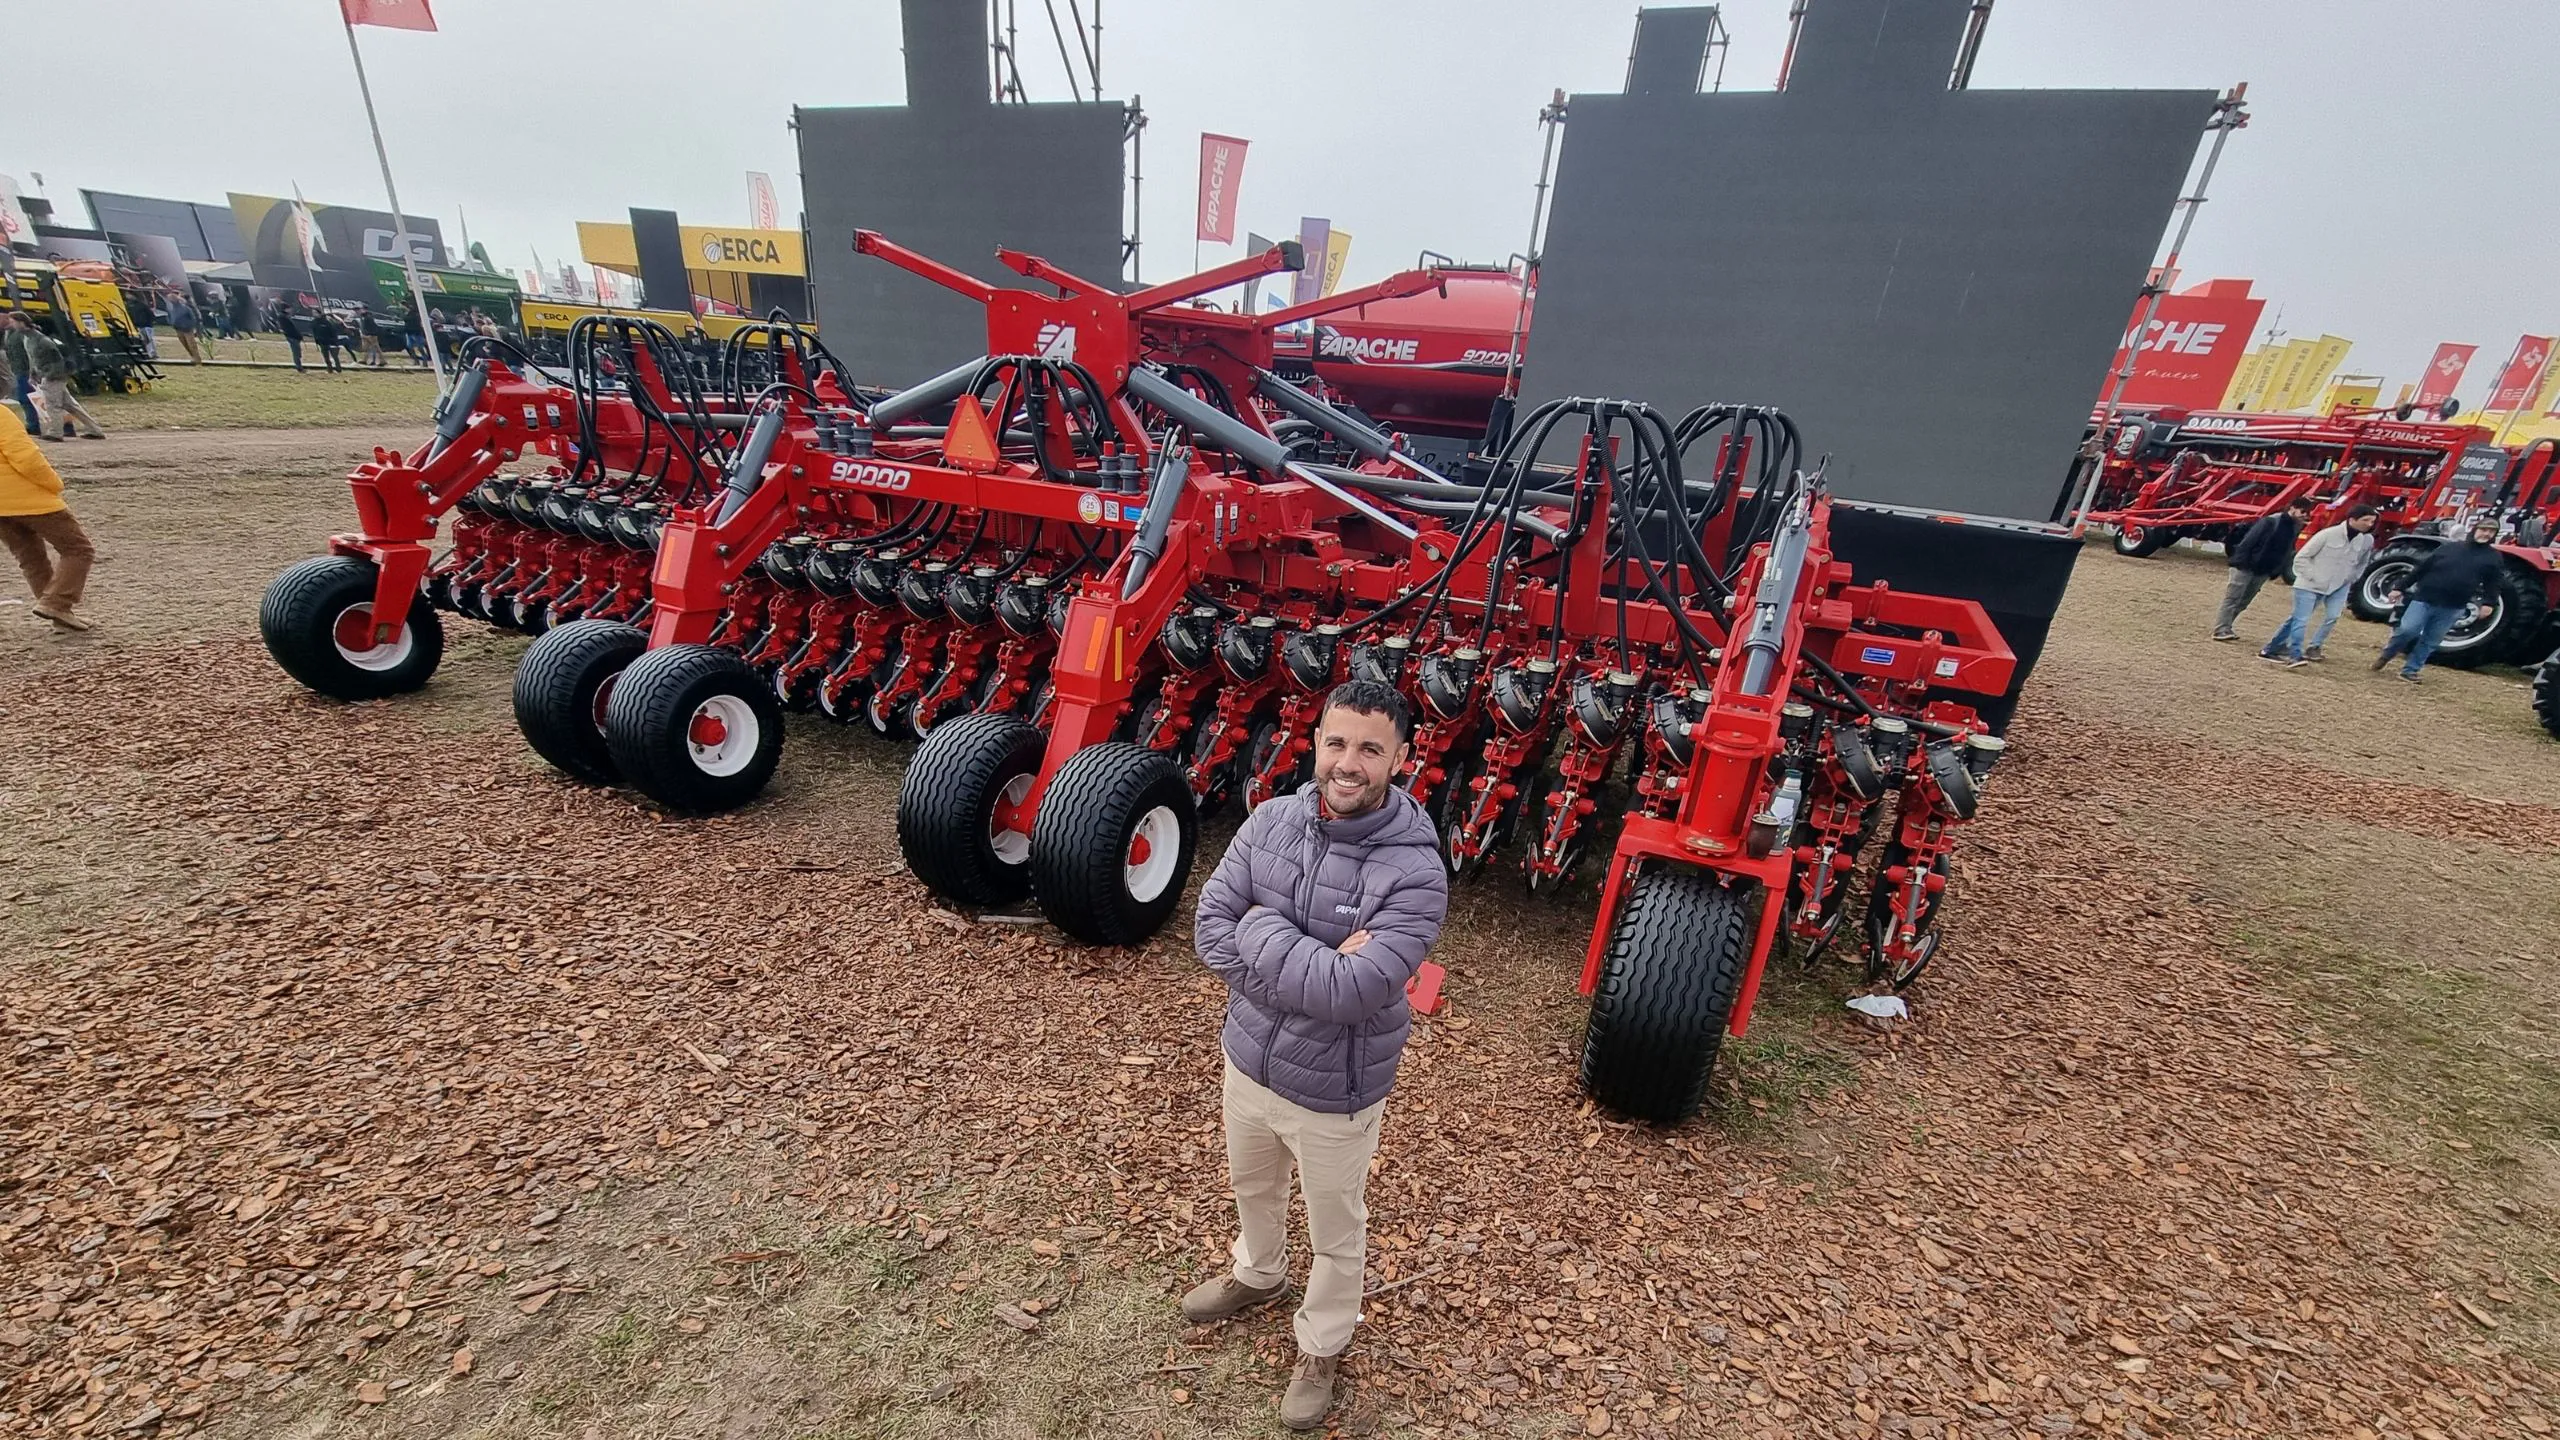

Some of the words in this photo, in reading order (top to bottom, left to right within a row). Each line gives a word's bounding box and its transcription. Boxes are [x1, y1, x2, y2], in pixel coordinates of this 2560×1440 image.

[1205, 146, 1228, 233] APACHE
[363, 227, 433, 263] DG
[721, 238, 780, 264] ERCA
[543, 311, 569, 322] ERCA
[1320, 335, 1419, 361] APACHE
[830, 461, 911, 491] 90000
